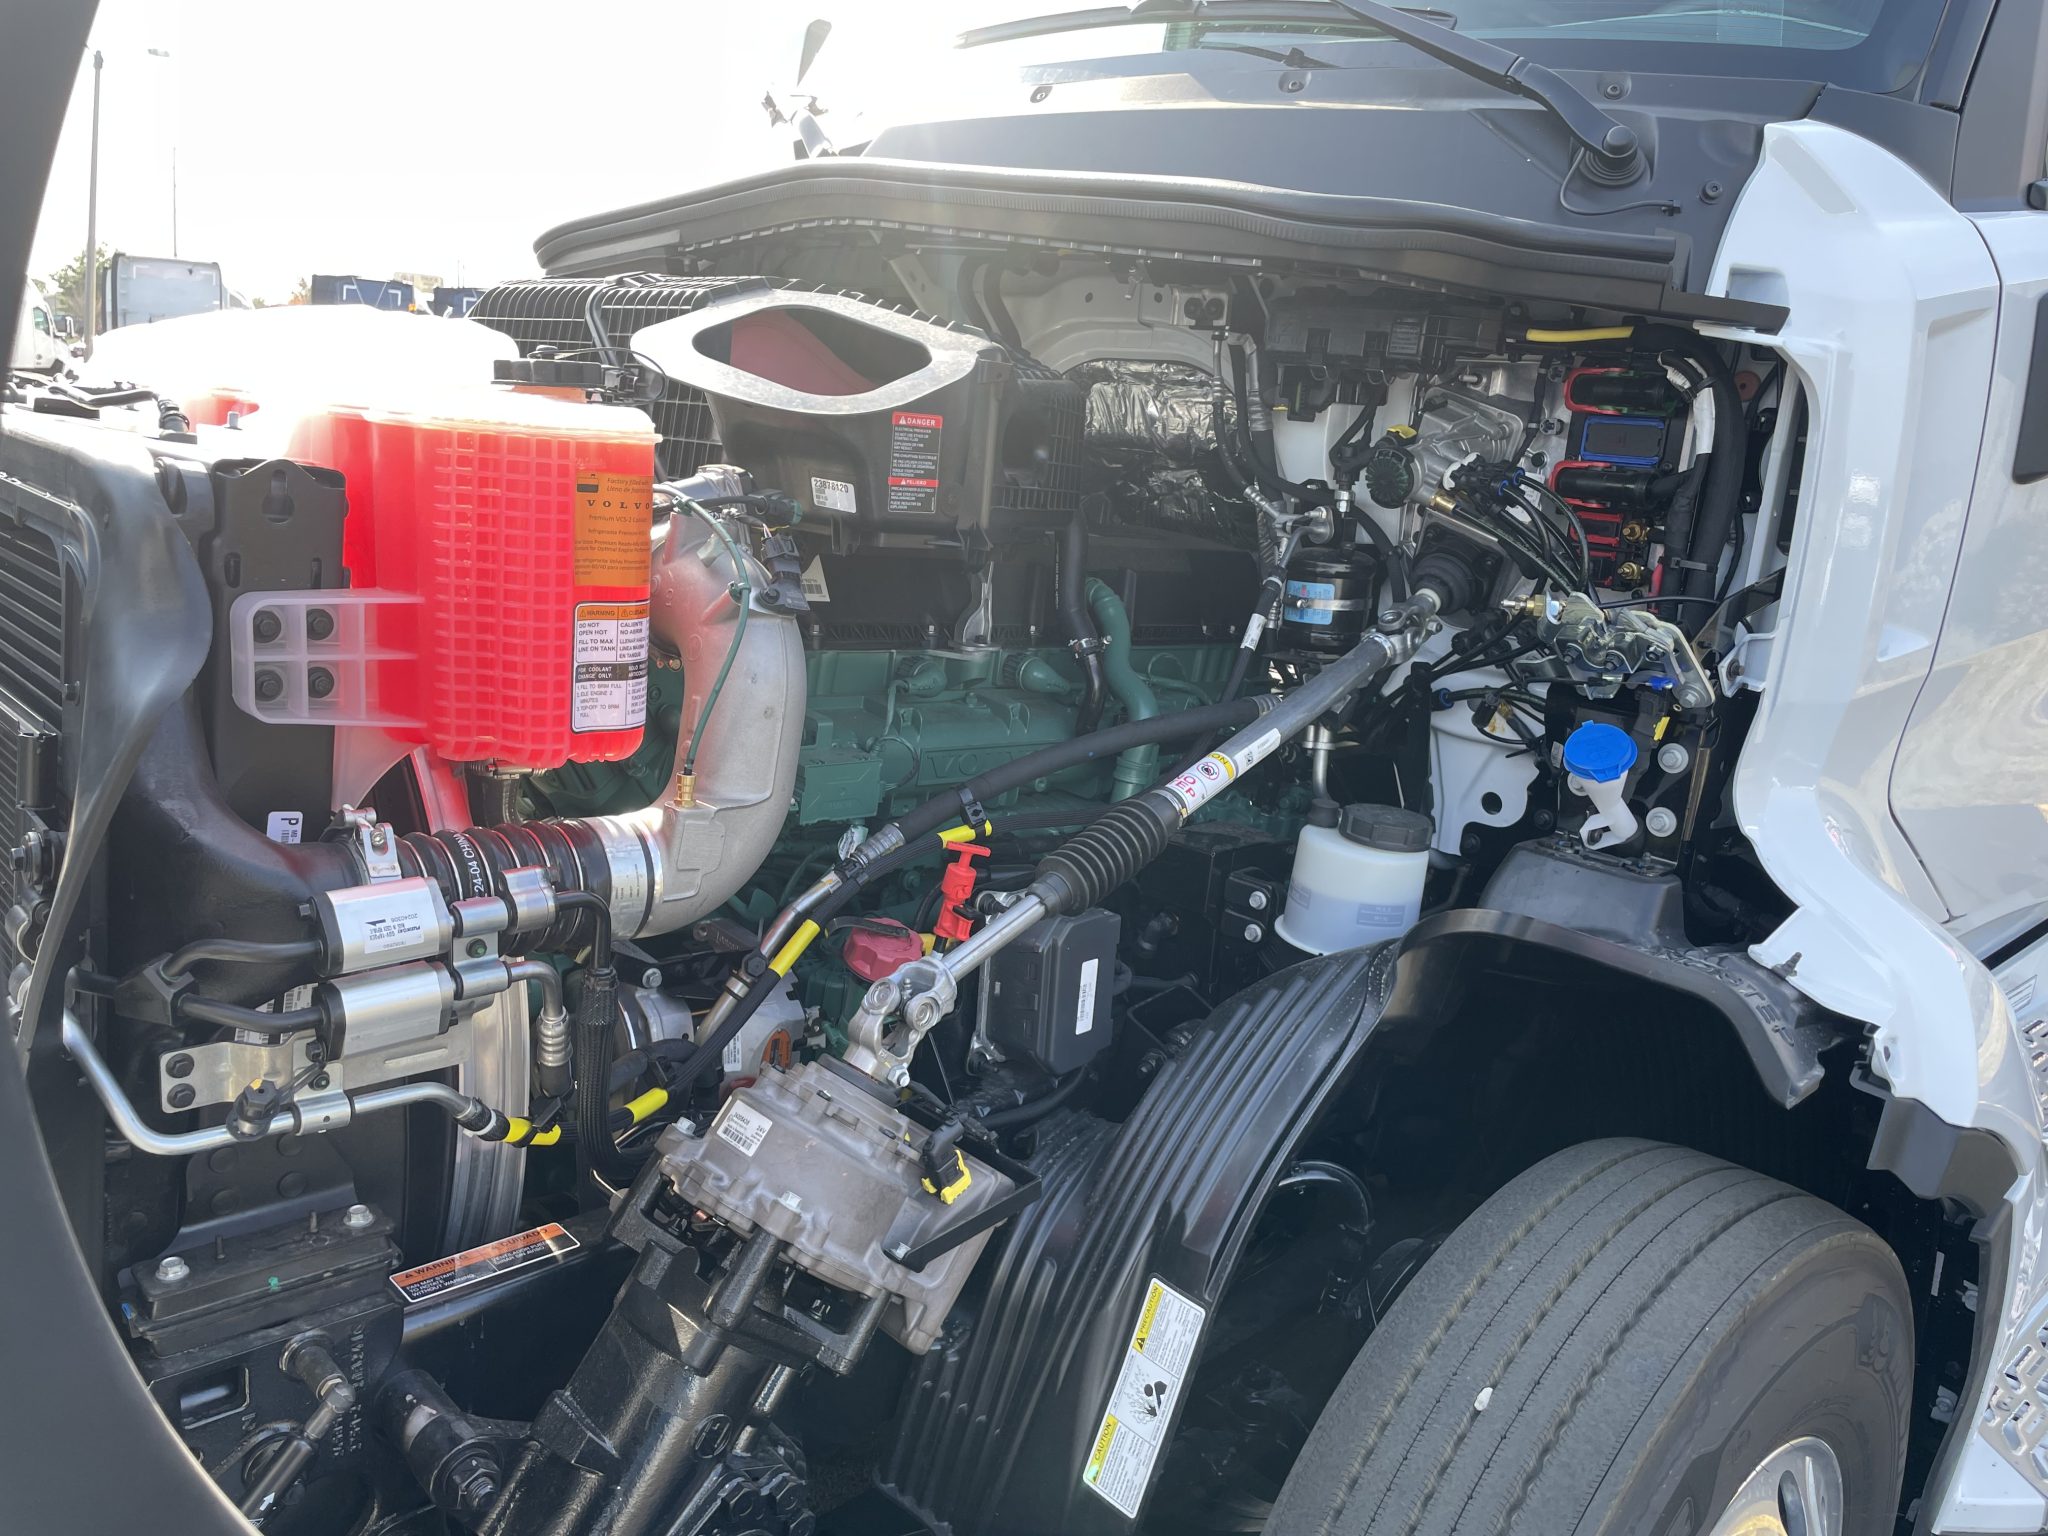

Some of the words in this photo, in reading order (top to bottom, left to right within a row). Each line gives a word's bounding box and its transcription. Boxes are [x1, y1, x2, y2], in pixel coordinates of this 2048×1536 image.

[907, 417, 936, 426] DANGER
[587, 500, 650, 510] VOLVO
[280, 816, 300, 826] P
[468, 860, 485, 892] 24-04
[501, 1228, 548, 1246] CUIDADO
[435, 1271, 455, 1281] START
[412, 1285, 443, 1297] WITHOUT
[1094, 1422, 1113, 1461] CAUTION
